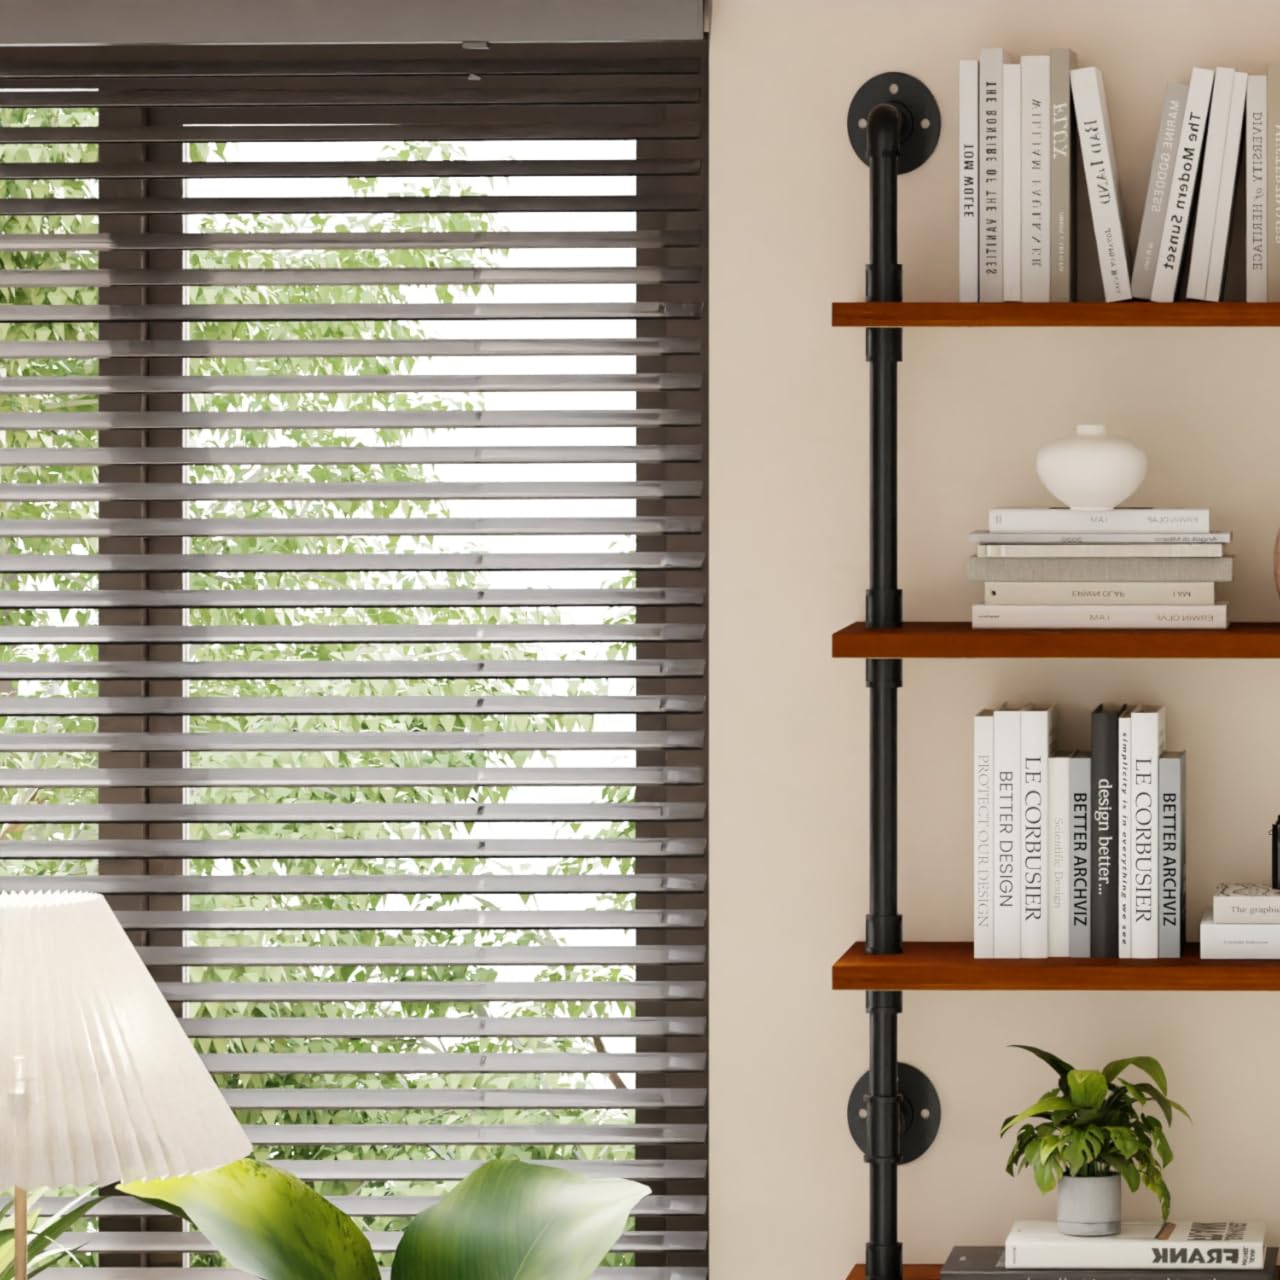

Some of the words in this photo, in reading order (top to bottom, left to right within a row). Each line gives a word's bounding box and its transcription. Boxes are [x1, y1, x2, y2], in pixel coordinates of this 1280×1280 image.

[1024, 756, 1042, 784] LE
[1120, 732, 1129, 795] simplicity
[1134, 758, 1152, 786] LE
[999, 770, 1013, 834] BETTER
[1072, 792, 1087, 851] BETTER
[1094, 778, 1113, 831] design
[1121, 800, 1128, 811] is
[1121, 814, 1128, 827] in
[1162, 792, 1177, 851] BETTER
[999, 839, 1013, 908] DESIGN
[1024, 789, 1042, 921] CORBUSIER
[1097, 836, 1113, 895] better...
[1120, 831, 1128, 900] everything
[1134, 791, 1152, 922] CORBUSIER
[1072, 855, 1087, 926] ARCHVIZ
[1121, 903, 1128, 921] we
[1162, 855, 1177, 926] ARCHVIZ
